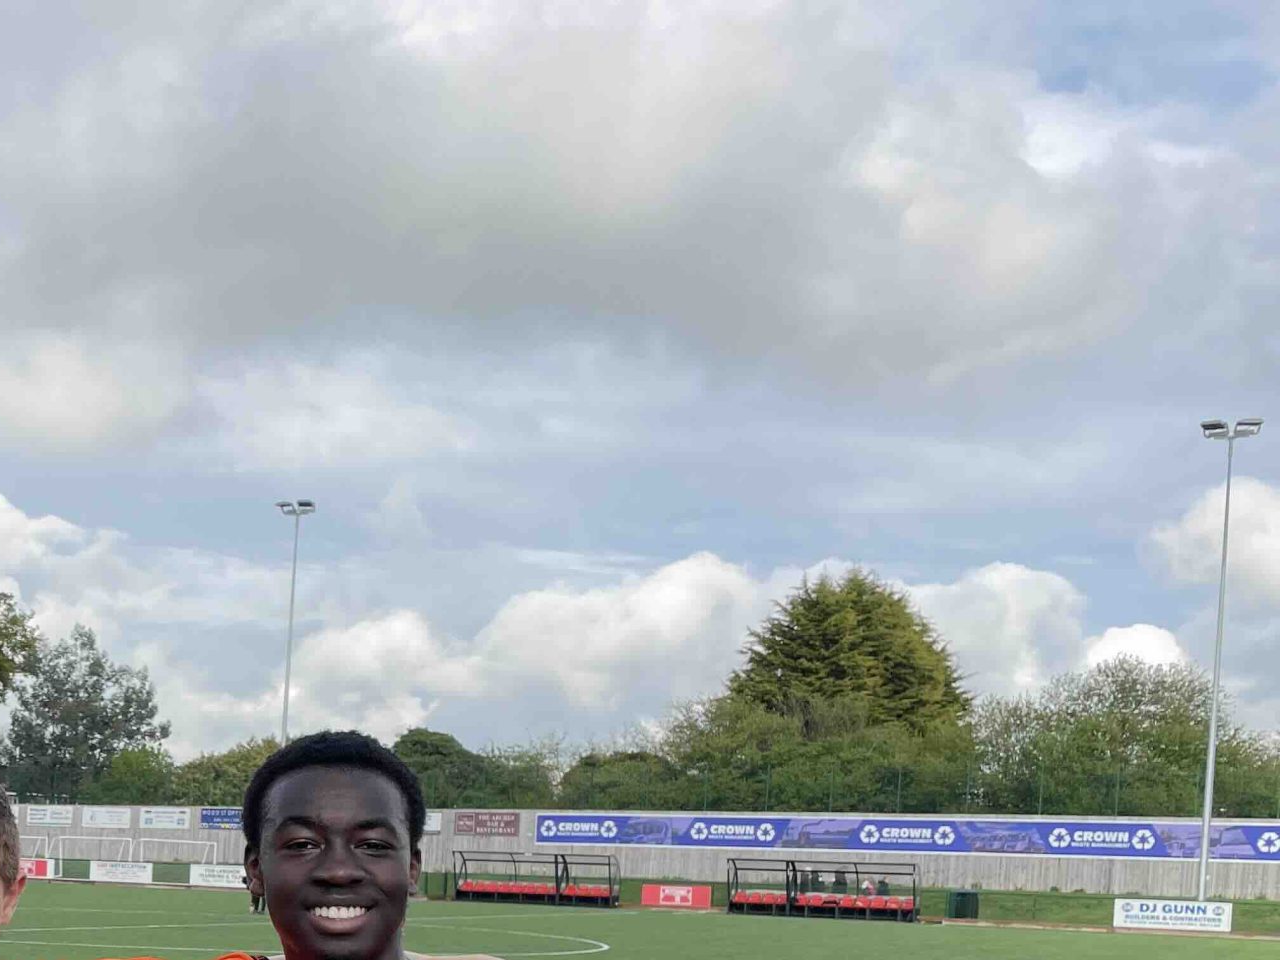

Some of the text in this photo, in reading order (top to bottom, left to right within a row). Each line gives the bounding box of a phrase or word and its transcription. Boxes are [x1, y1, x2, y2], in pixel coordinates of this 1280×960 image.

[558, 822, 599, 831] CROWN
[710, 824, 755, 834] CROWN
[882, 828, 932, 838] CROWN
[1073, 831, 1129, 842] CROWN
[1140, 903, 1207, 915] DJ GUNN
